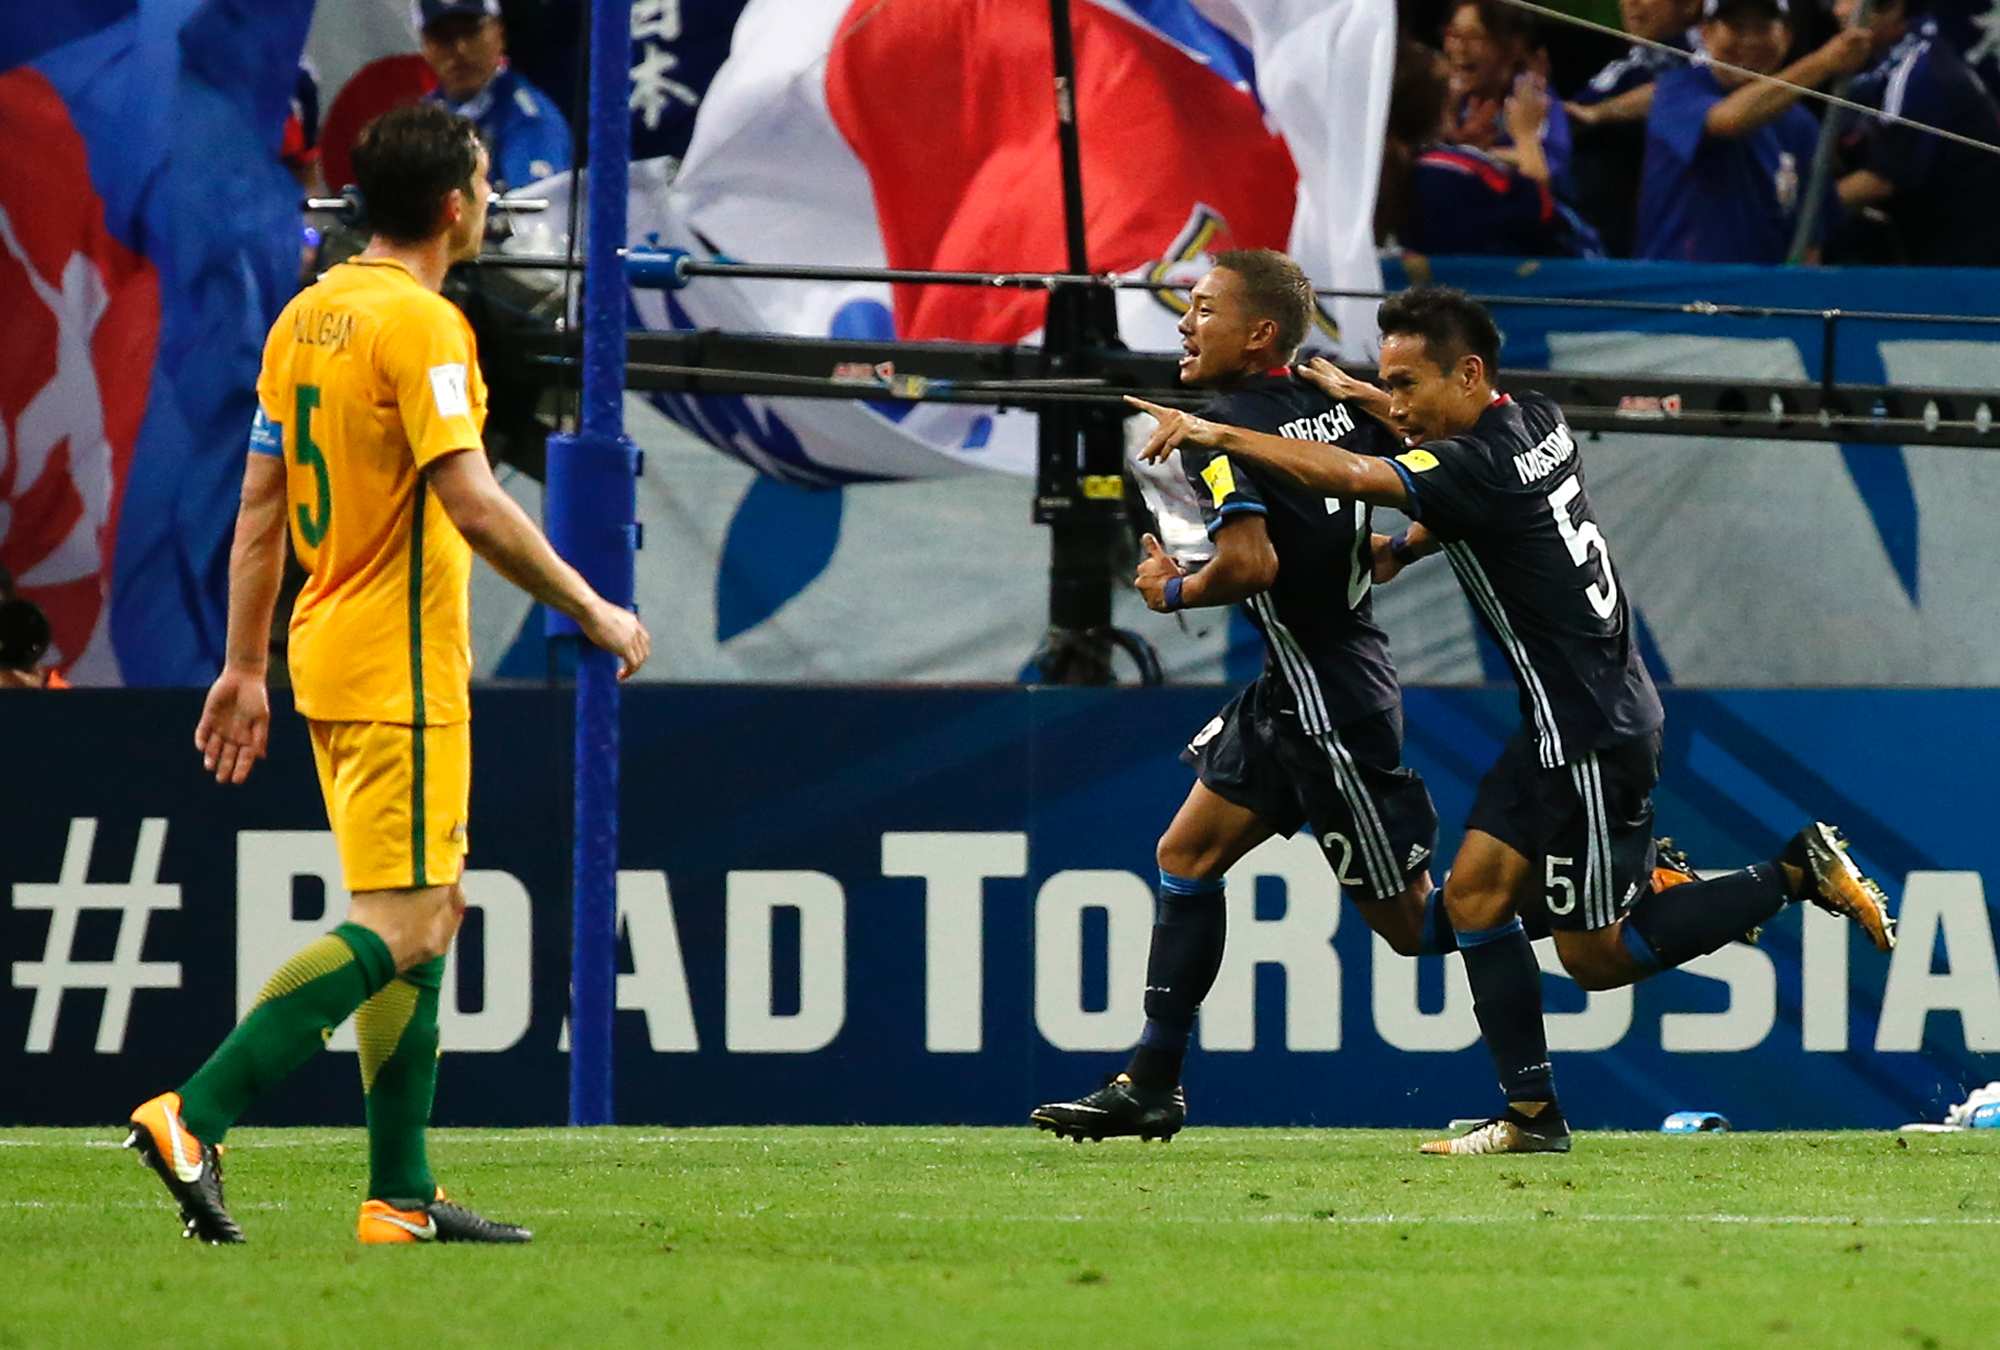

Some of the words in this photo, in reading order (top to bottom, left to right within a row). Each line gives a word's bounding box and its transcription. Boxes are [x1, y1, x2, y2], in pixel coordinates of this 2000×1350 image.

[296, 385, 331, 547] 5
[1547, 474, 1617, 620] 5
[1323, 832, 1363, 885] 2
[1546, 855, 1576, 915] 5
